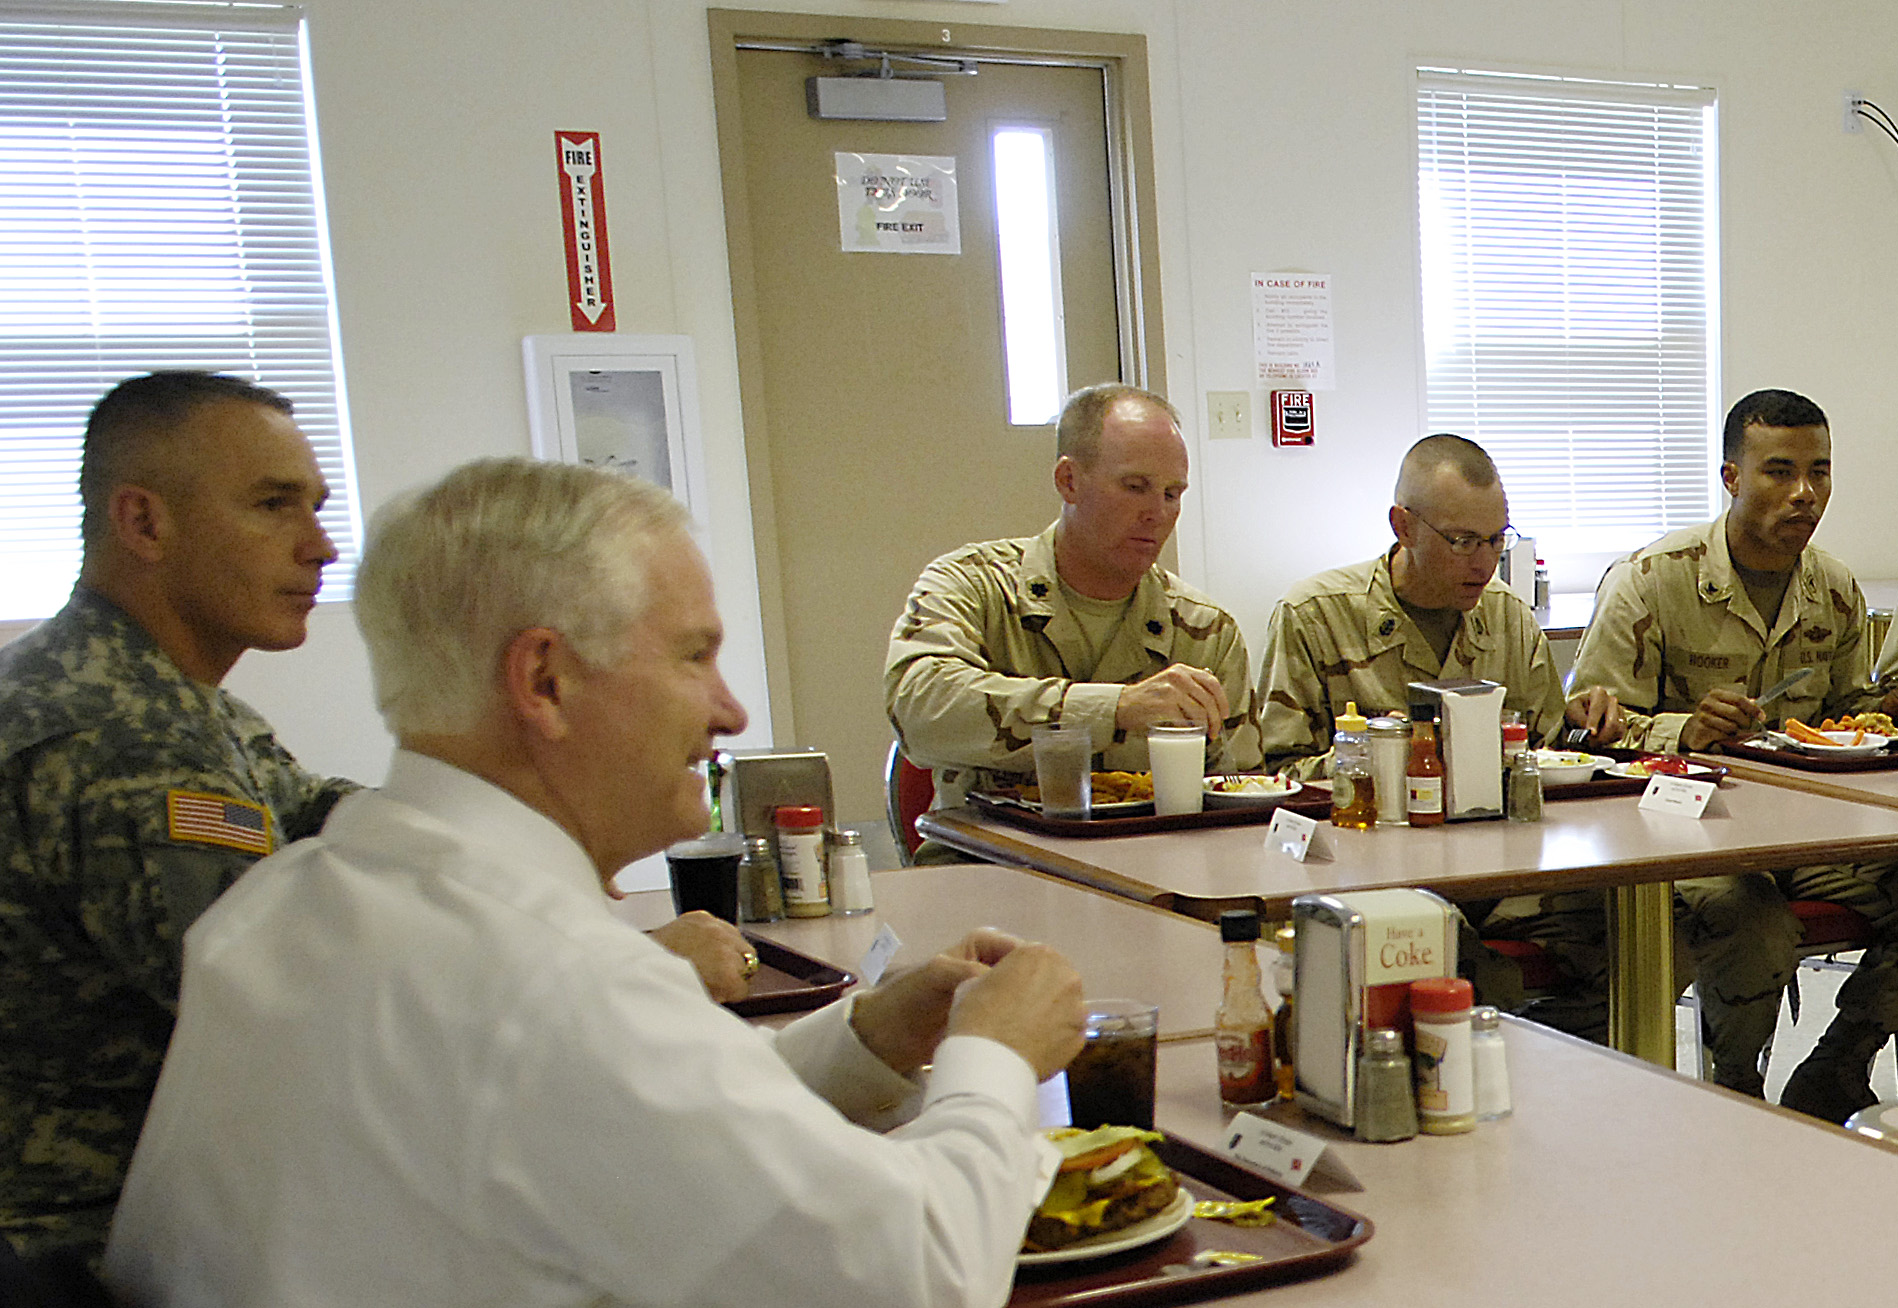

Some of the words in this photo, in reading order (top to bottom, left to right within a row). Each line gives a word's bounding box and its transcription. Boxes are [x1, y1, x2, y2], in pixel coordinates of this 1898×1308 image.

[565, 150, 593, 166] FIRE
[876, 222, 899, 232] FIRE
[901, 223, 924, 232] EXIT
[576, 175, 597, 307] EXTINGUISHER
[1255, 279, 1264, 287] IN
[1267, 280, 1291, 288] CASE
[1308, 281, 1326, 289] FIRE
[1281, 394, 1310, 406] FIRE
[1689, 653, 1730, 669] HOOKER
[1387, 926, 1413, 939] Have
[1380, 942, 1433, 969] Coke
